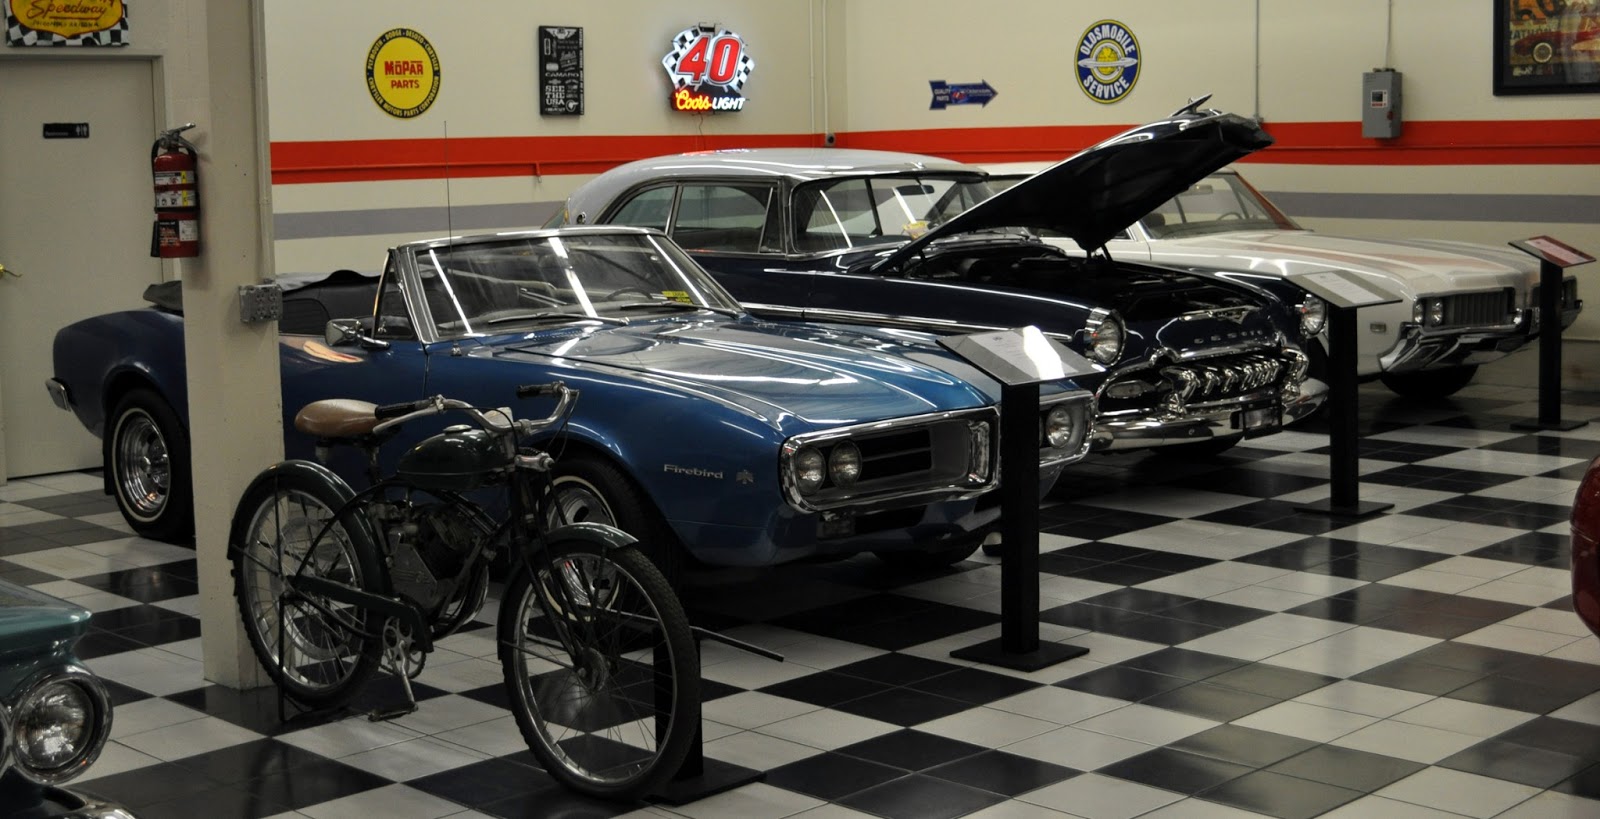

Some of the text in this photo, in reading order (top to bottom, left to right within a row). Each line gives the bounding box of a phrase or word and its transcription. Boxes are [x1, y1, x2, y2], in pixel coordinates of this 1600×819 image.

[27, 0, 107, 19] Speedway
[1080, 24, 1136, 56] OLDSMOBILE
[384, 60, 424, 76] MOPAR
[676, 35, 742, 85] 40
[391, 79, 420, 89] PARTS
[1083, 74, 1130, 99] SERVICE
[545, 98, 566, 106] USA
[675, 89, 746, 110] Coors LIGHT
[403, 108, 420, 117] PARTS
[663, 464, 724, 479] Firebird
